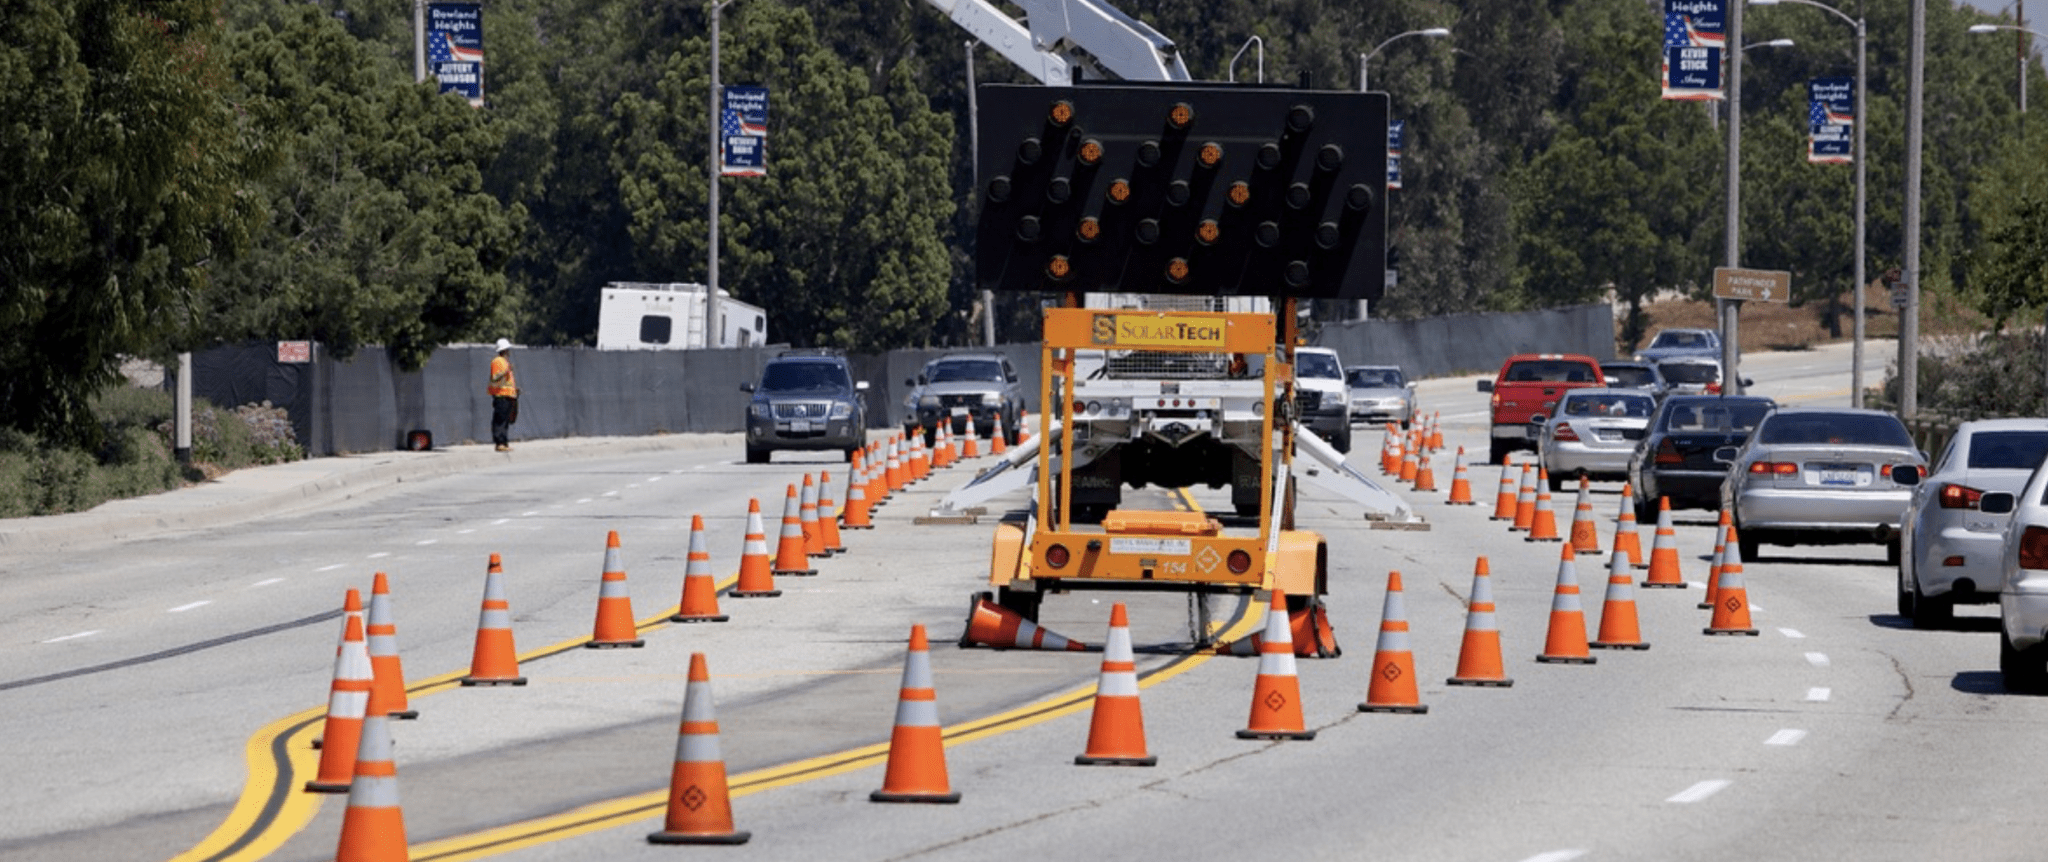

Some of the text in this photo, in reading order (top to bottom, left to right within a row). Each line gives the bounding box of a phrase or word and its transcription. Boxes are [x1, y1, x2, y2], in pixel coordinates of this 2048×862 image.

[1672, 1, 1718, 14] Heights
[432, 9, 478, 19] Rowland
[434, 20, 476, 32] Heights
[1680, 48, 1708, 59] KEVIN
[1680, 60, 1708, 71] STICK
[727, 91, 765, 101] Rowland
[728, 101, 762, 111] Heights
[1727, 276, 1777, 288] PATHFINDER
[1731, 287, 1752, 296] PARK
